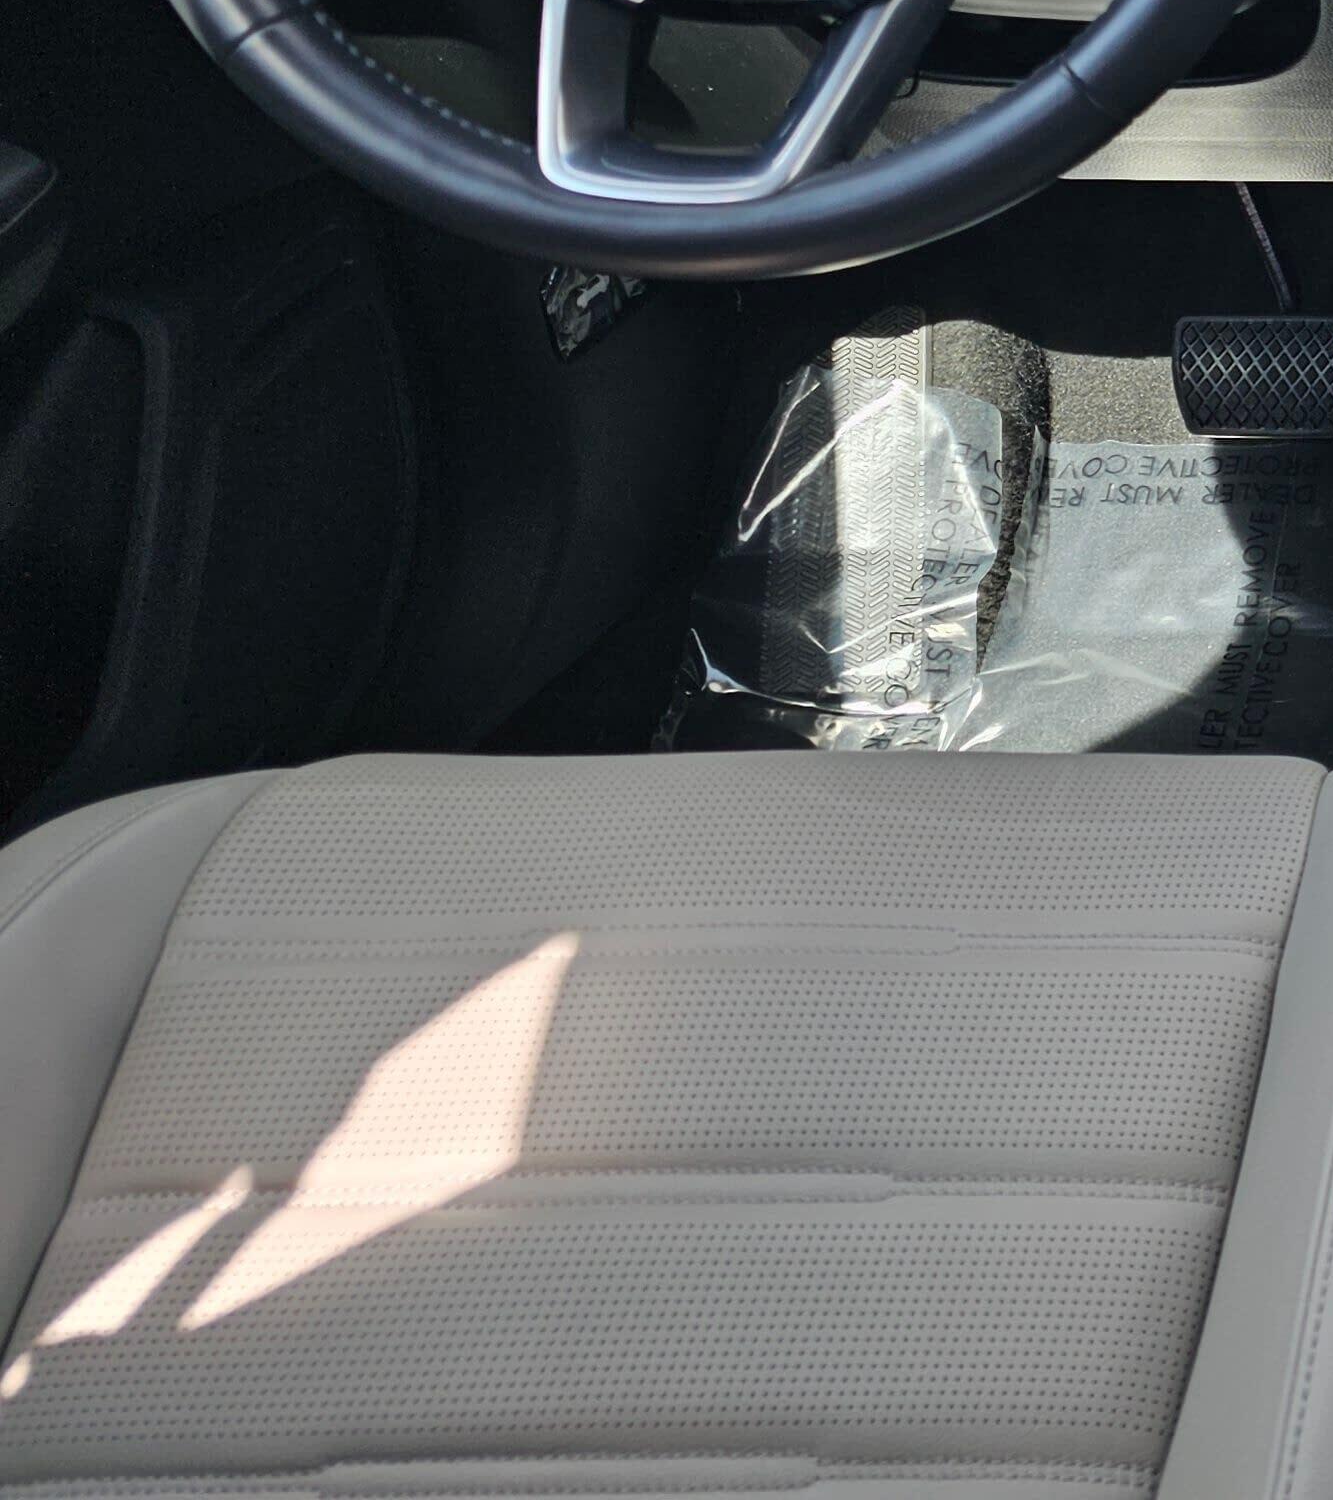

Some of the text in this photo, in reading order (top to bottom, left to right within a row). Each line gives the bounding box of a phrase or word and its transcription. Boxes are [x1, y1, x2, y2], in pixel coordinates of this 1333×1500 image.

[1100, 482, 1184, 505] MUST
[1233, 510, 1275, 628] REMOVE
[1216, 642, 1252, 695] MUST
